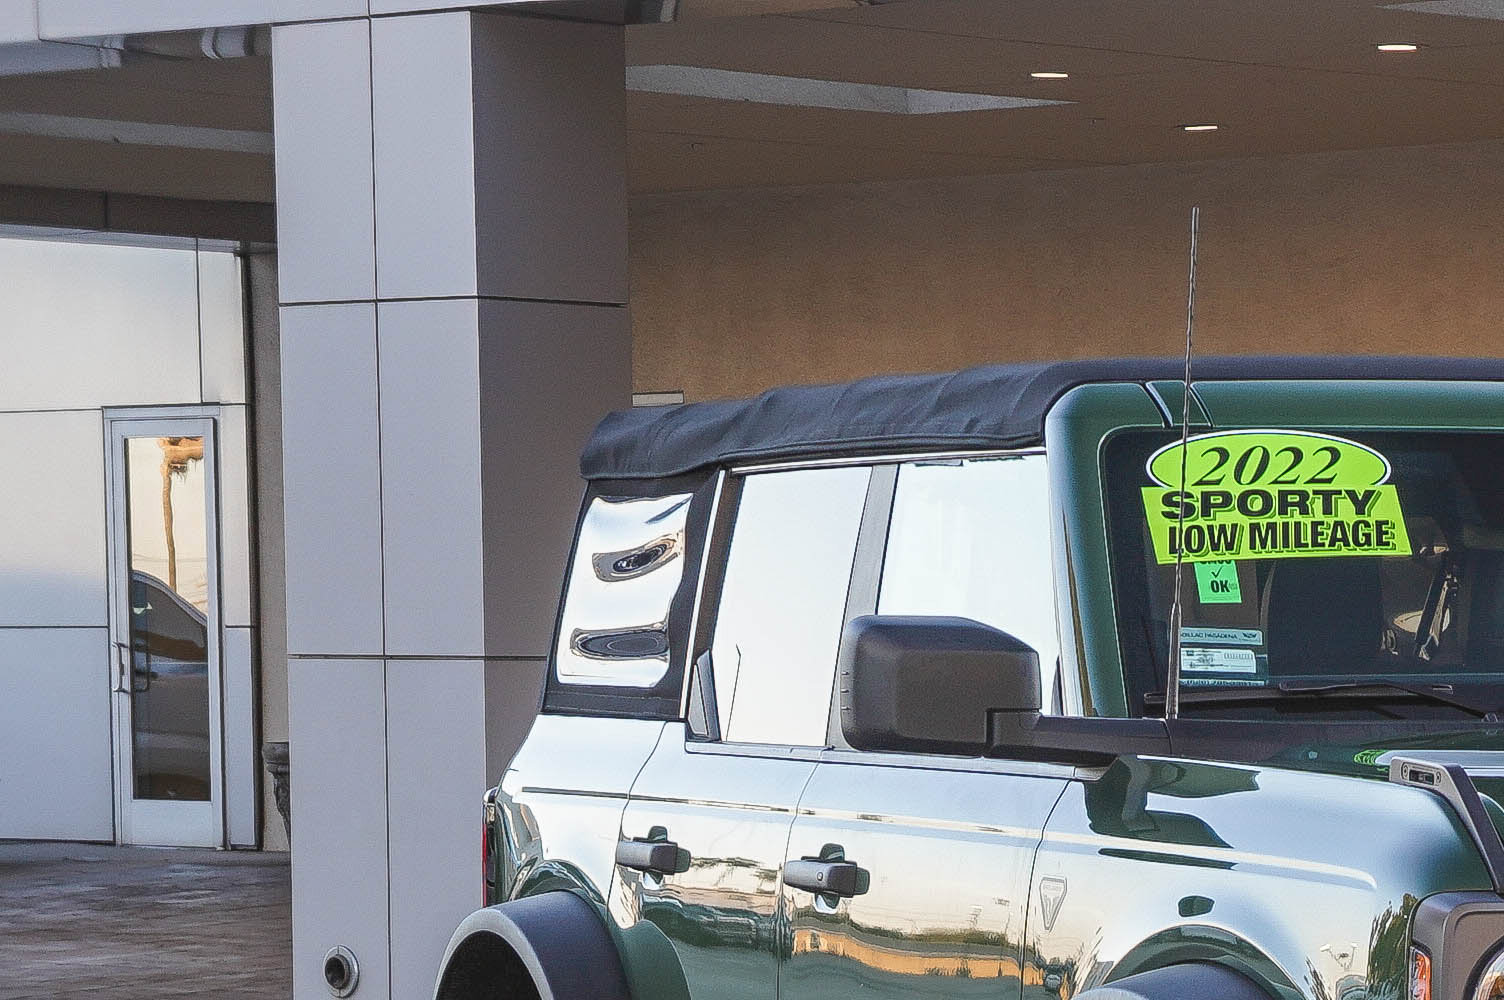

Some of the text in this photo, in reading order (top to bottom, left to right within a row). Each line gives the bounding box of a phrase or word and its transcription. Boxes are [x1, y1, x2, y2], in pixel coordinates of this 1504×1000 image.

[1192, 446, 1341, 486] 2022
[1161, 489, 1382, 520] SPORTY
[1168, 520, 1397, 557] LOW MILEAGE
[1210, 580, 1230, 593] OK
